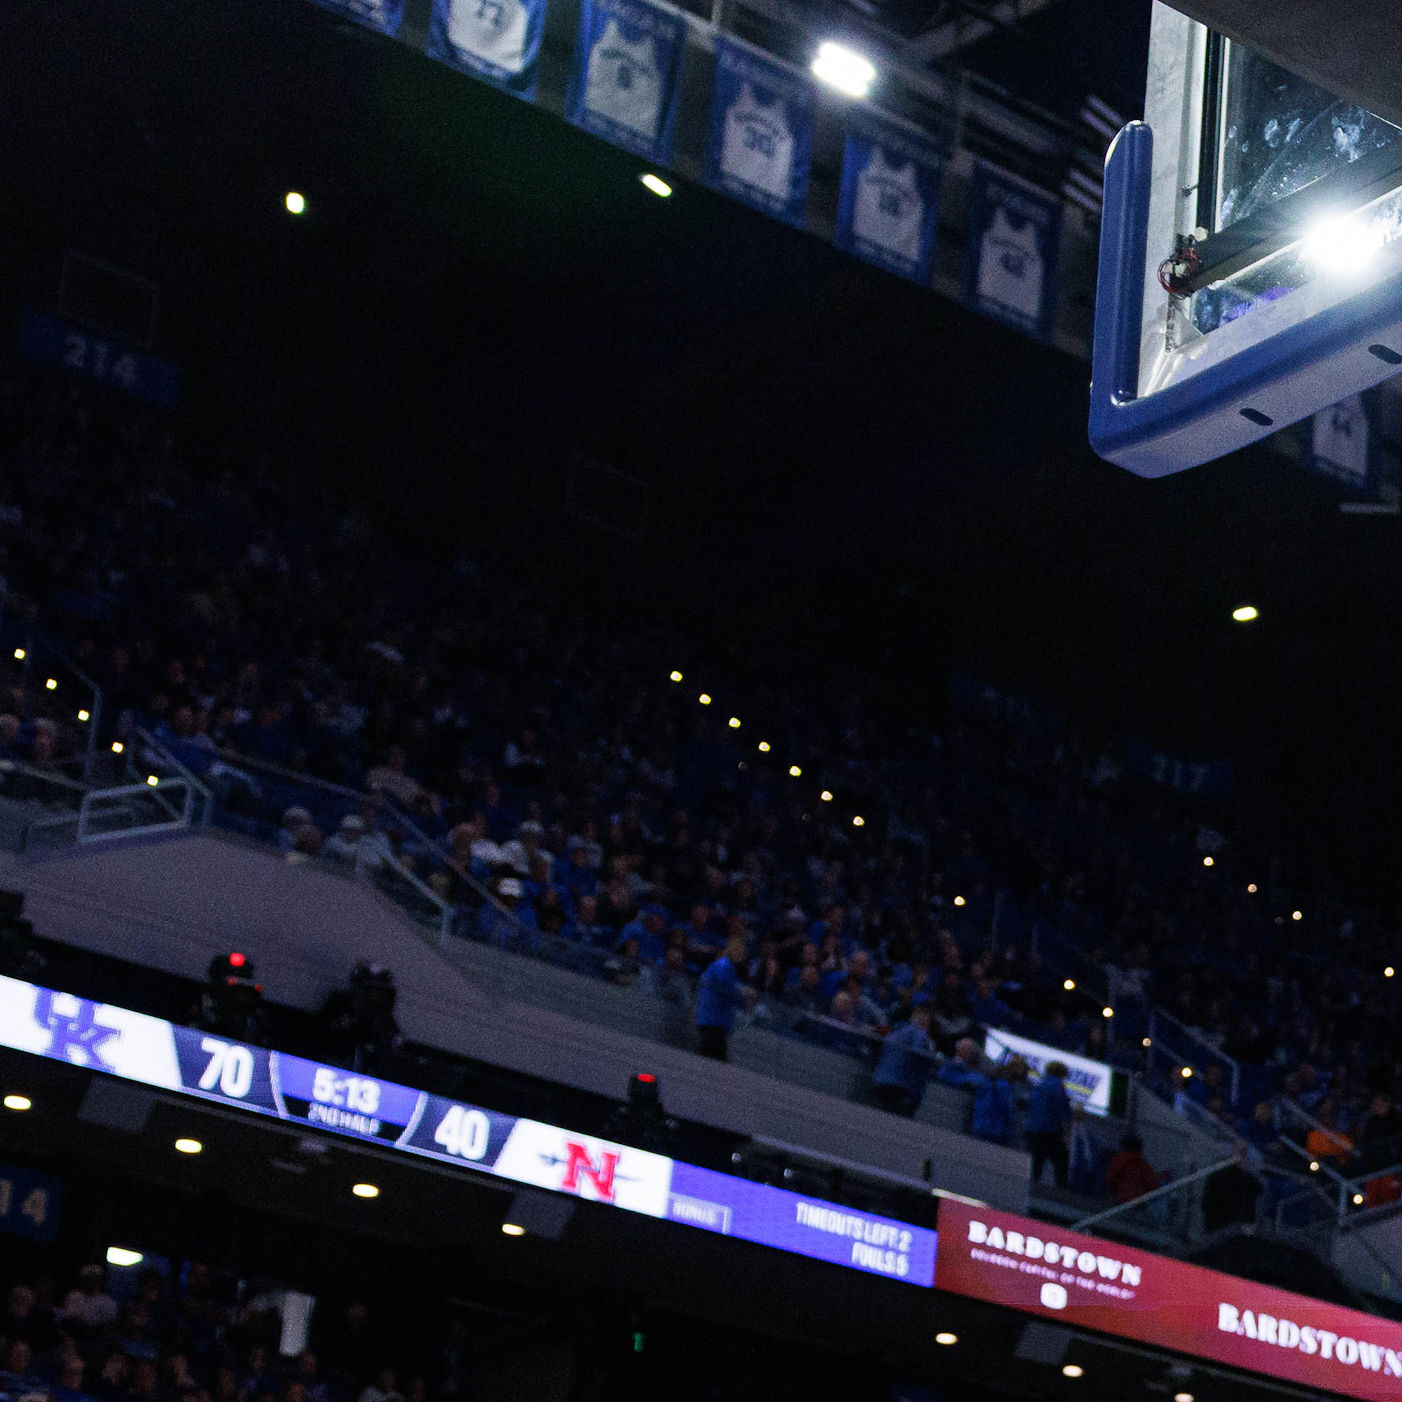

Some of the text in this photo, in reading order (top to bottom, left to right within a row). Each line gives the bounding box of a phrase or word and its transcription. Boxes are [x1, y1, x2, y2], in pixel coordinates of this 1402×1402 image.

[199, 1037, 254, 1099] 70
[312, 1066, 382, 1115] 5:13
[434, 1104, 491, 1162] 40
[561, 1140, 621, 1205] N
[968, 1220, 1142, 1287] BARDSTOWN
